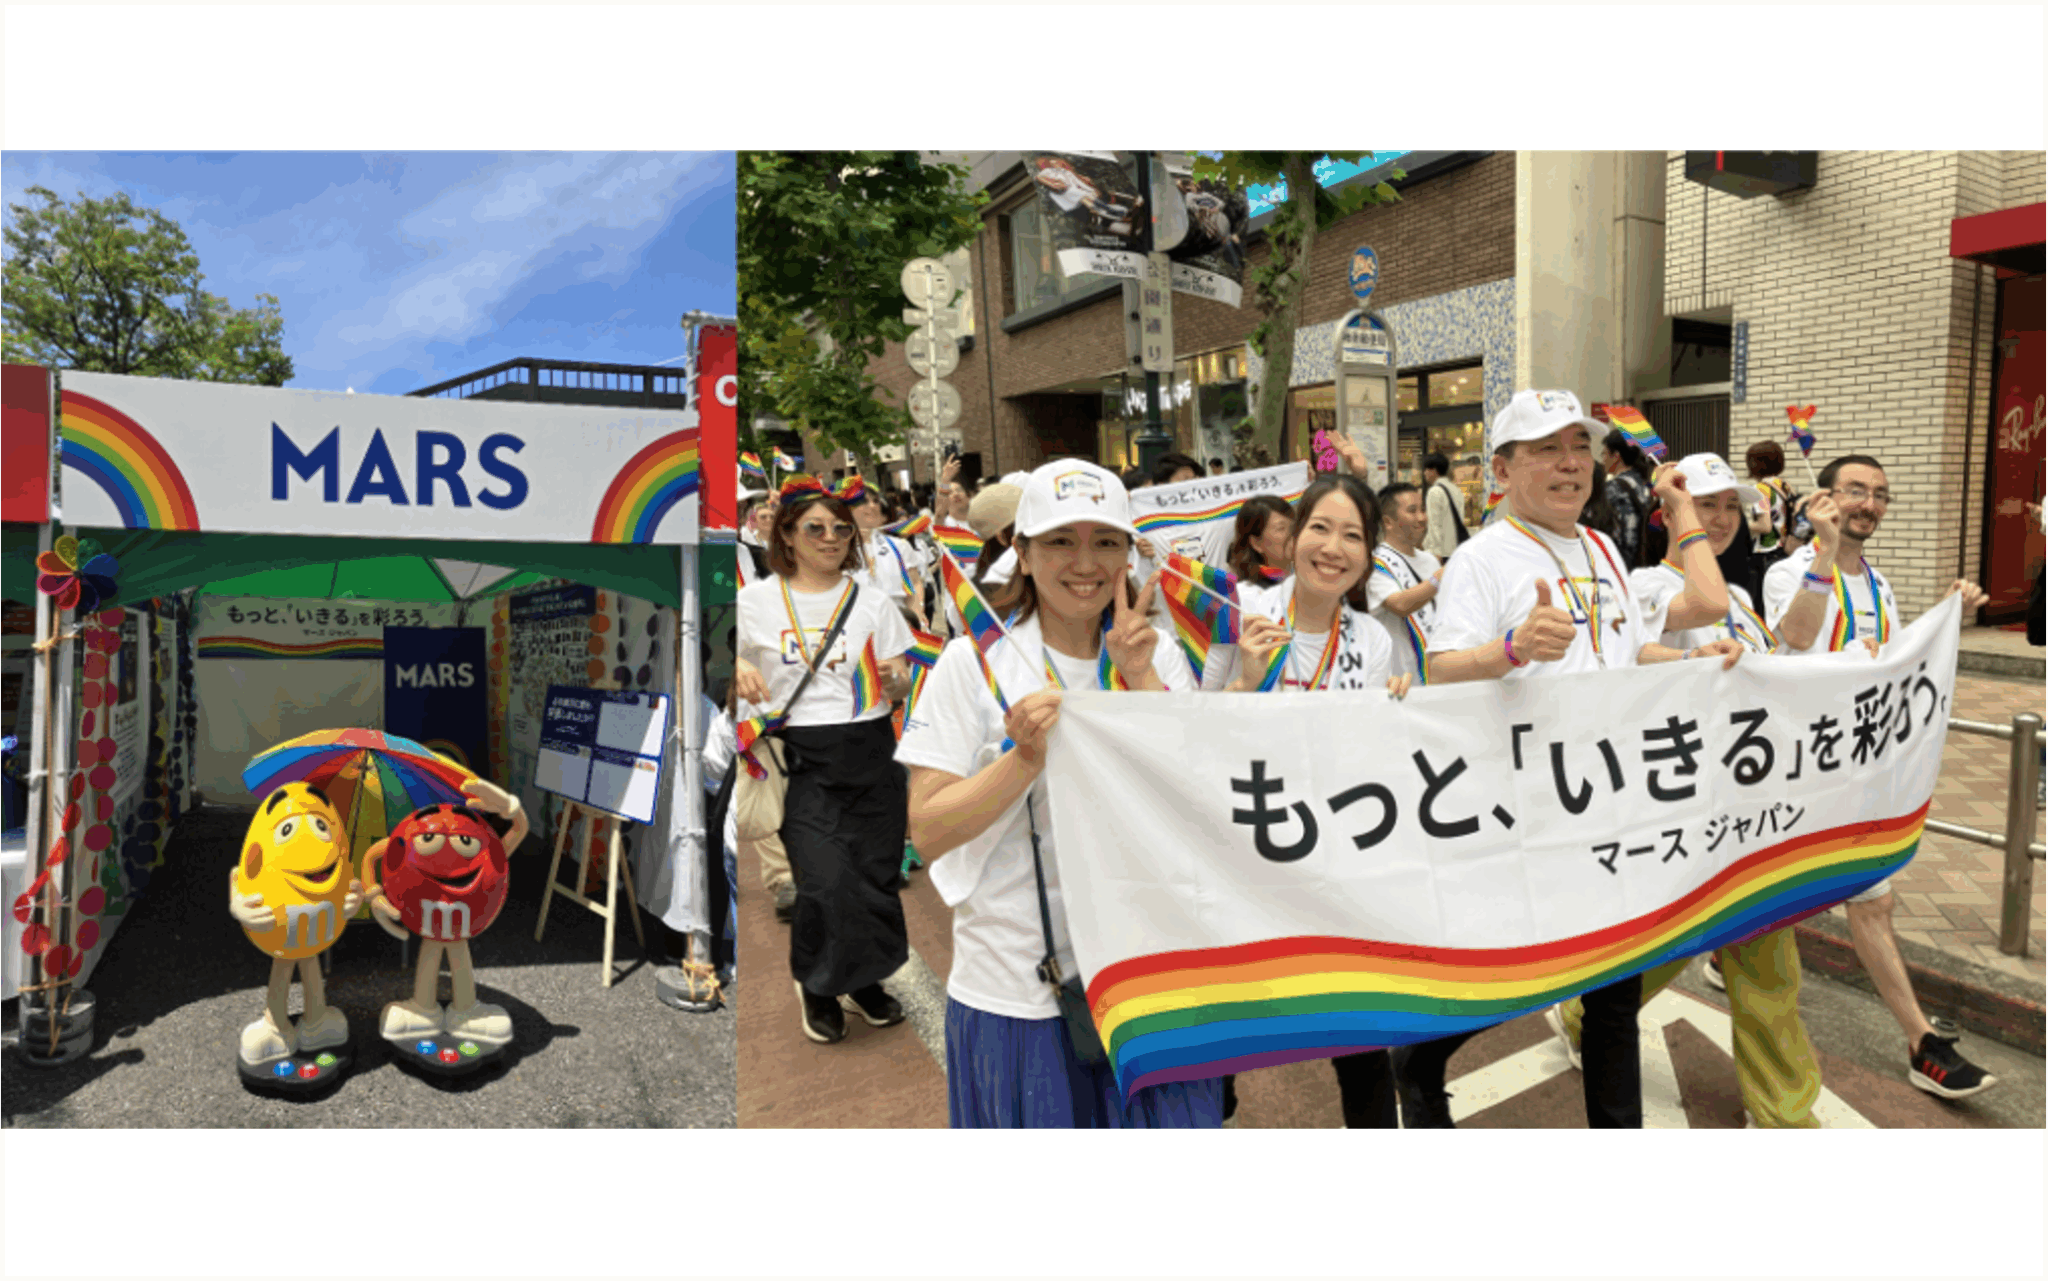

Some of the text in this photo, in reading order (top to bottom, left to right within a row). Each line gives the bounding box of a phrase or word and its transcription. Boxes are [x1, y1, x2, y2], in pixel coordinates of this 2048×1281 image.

[271, 420, 530, 511] MARS
[395, 662, 475, 688] MARS
[1591, 803, 1806, 874] マース ジャパン
[284, 900, 336, 949] m
[420, 898, 471, 939] m
